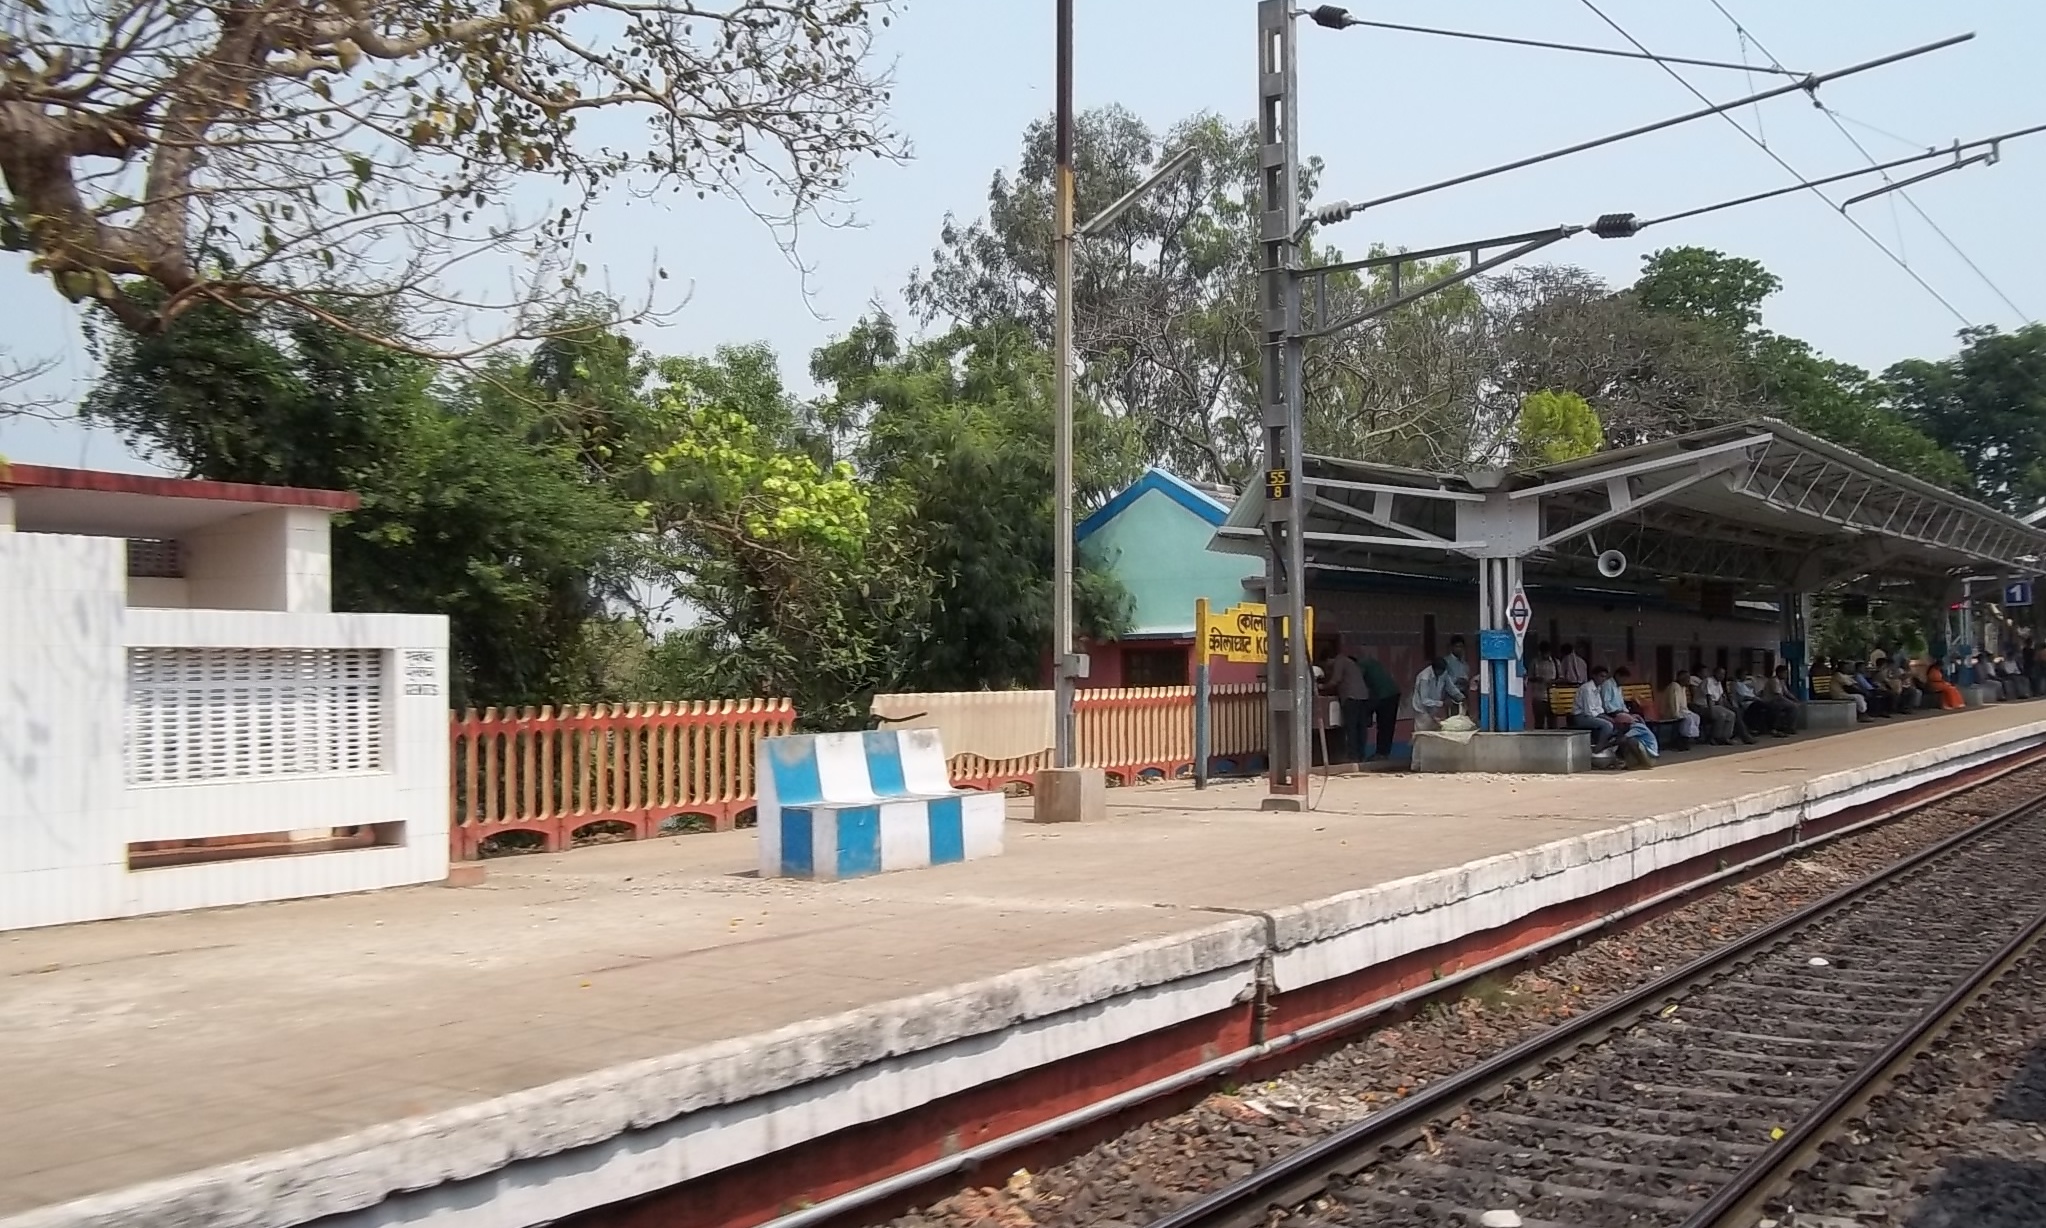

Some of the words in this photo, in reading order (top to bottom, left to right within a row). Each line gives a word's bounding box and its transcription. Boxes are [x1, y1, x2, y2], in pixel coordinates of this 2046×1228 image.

[1270, 471, 1286, 484] 55
[1274, 486, 1282, 498] 8
[2009, 584, 2022, 602] 1
